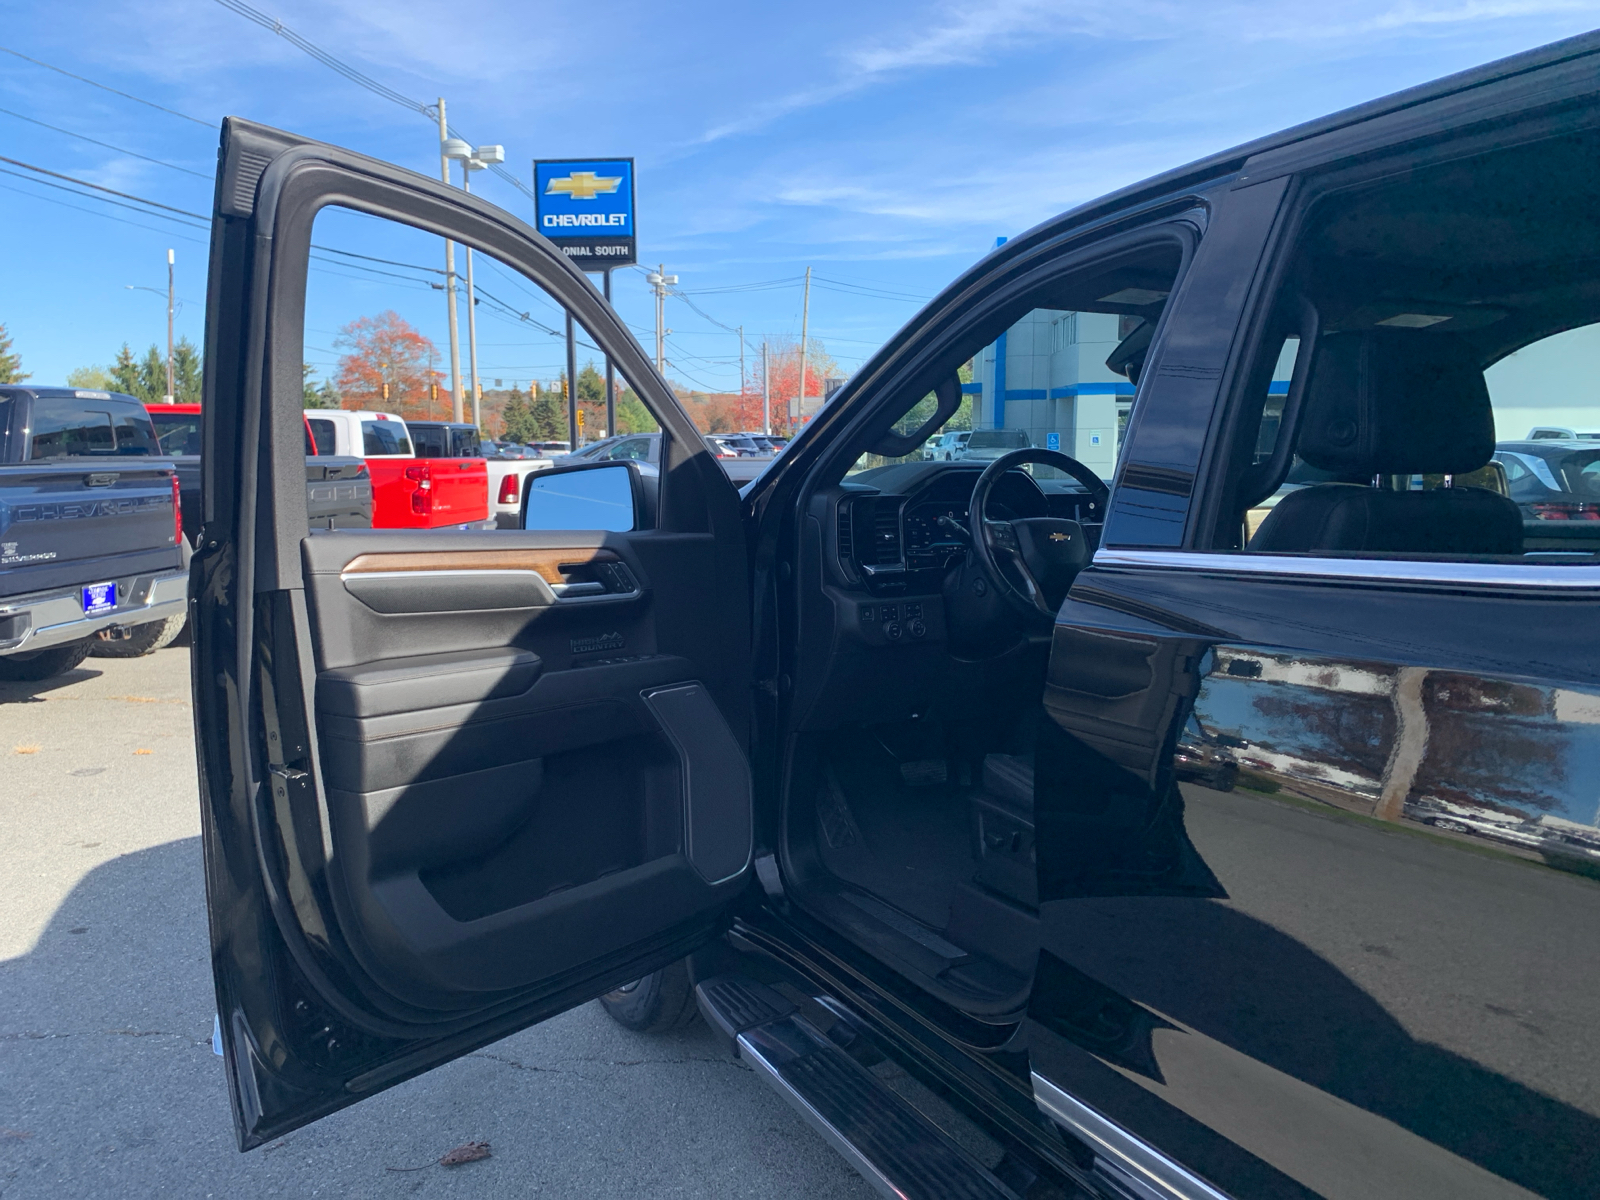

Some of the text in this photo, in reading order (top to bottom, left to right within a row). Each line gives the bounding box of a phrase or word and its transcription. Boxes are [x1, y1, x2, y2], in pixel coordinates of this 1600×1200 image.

[543, 213, 627, 227] CHEVROLET
[562, 246, 629, 256] ONIAL SOUTH
[309, 485, 370, 501] ORD
[16, 497, 170, 523] CHEVROLET
[573, 638, 600, 647] HIGH
[573, 641, 624, 653] COUNTRY
